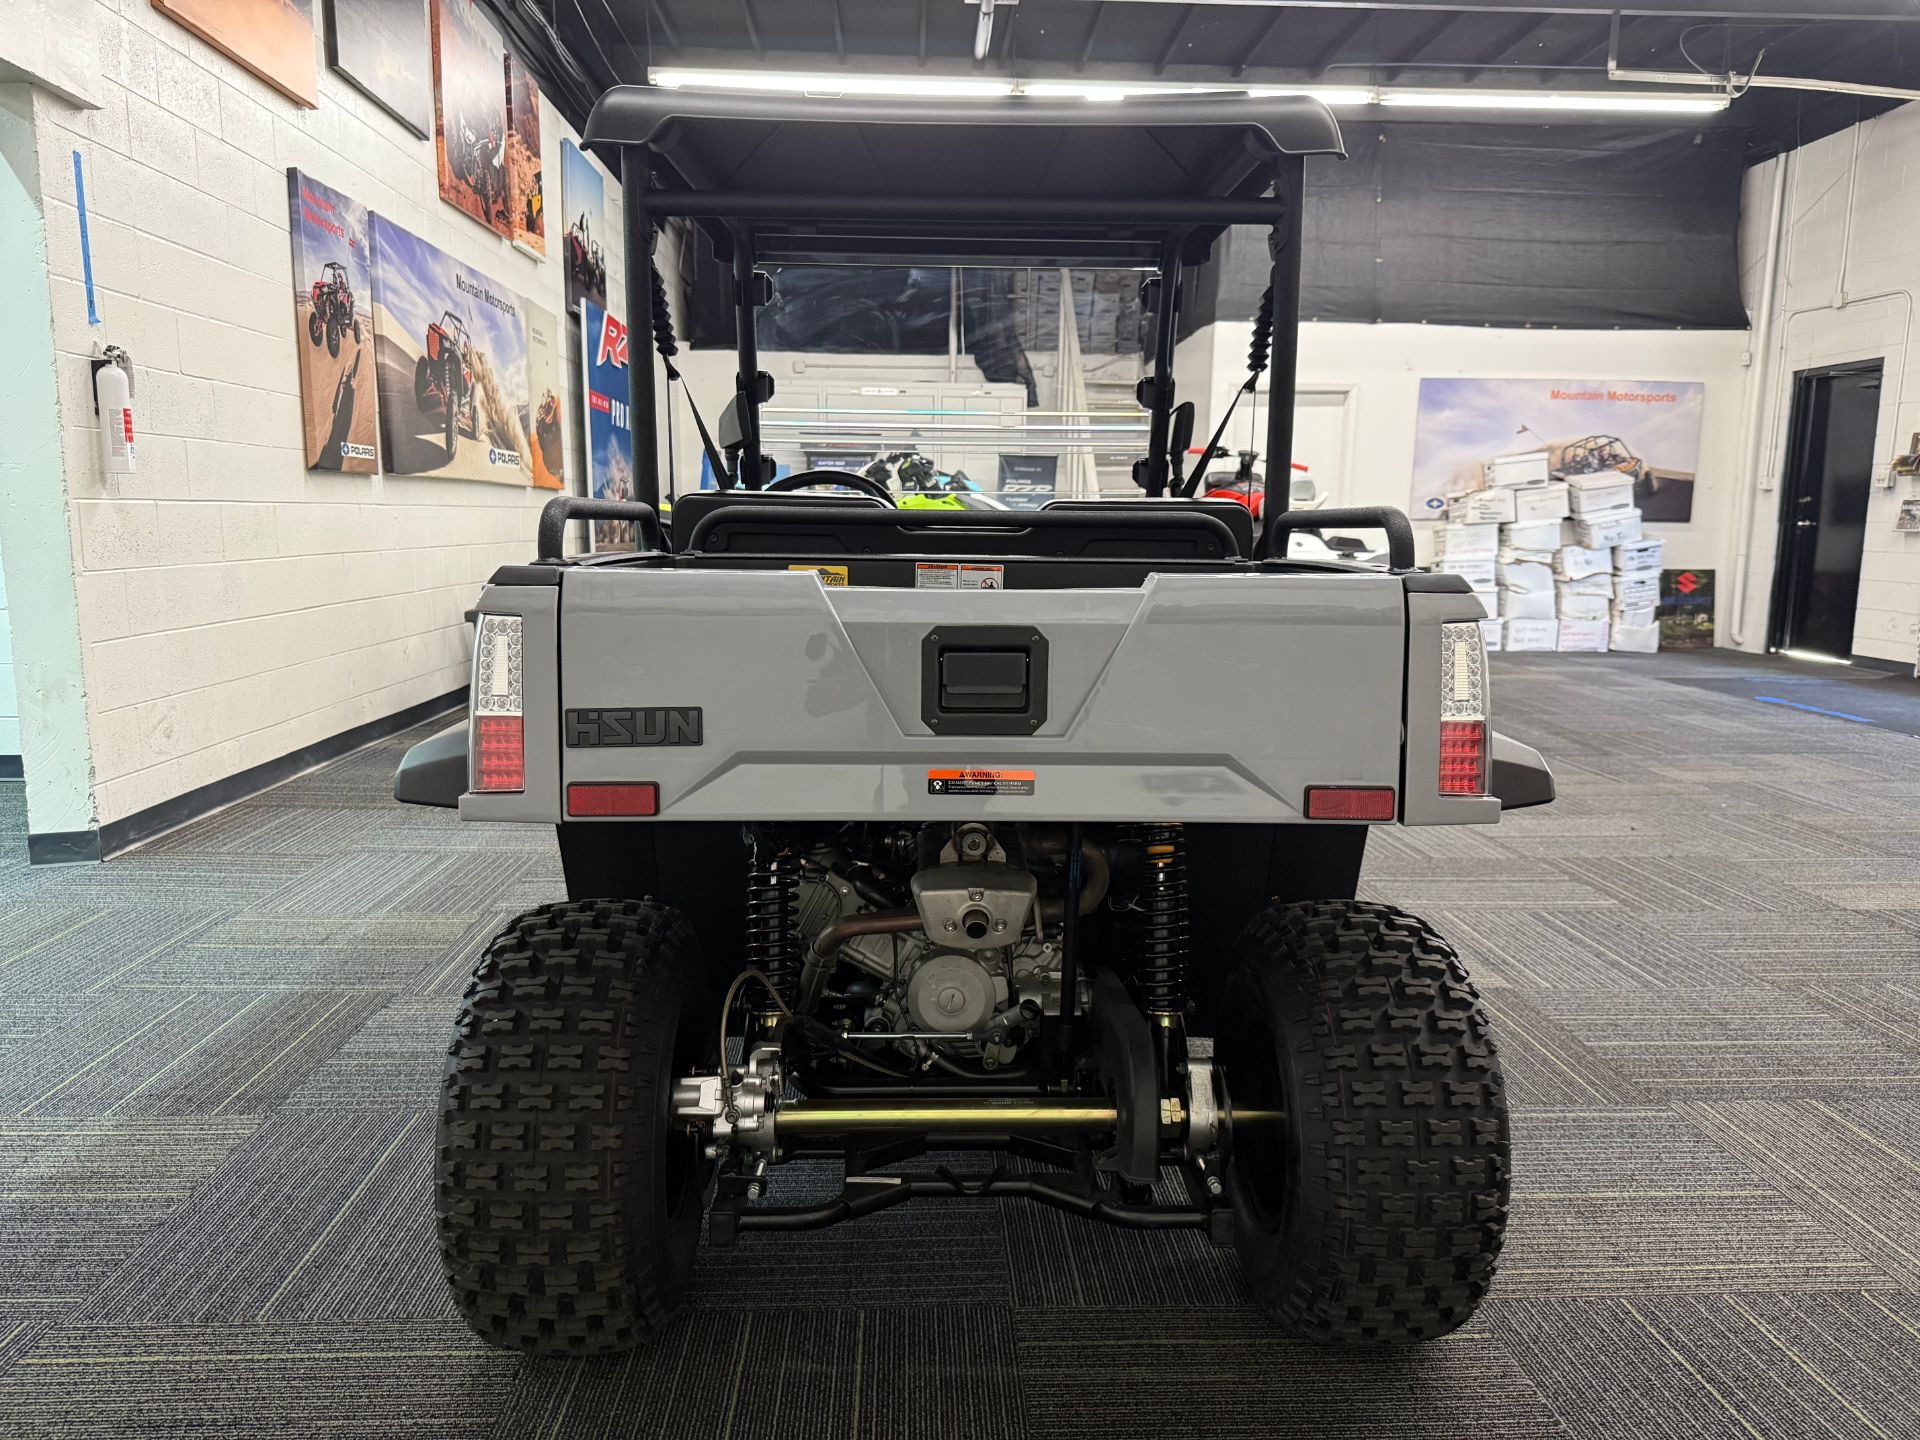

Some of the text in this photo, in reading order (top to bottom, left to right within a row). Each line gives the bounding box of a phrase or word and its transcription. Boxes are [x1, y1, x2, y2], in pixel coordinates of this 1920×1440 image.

[456, 273, 516, 318] Mountain Motorsports
[1551, 390, 1677, 404] Mountain Motorsports
[350, 446, 375, 457] POLARIS
[497, 452, 520, 465] POLARIS
